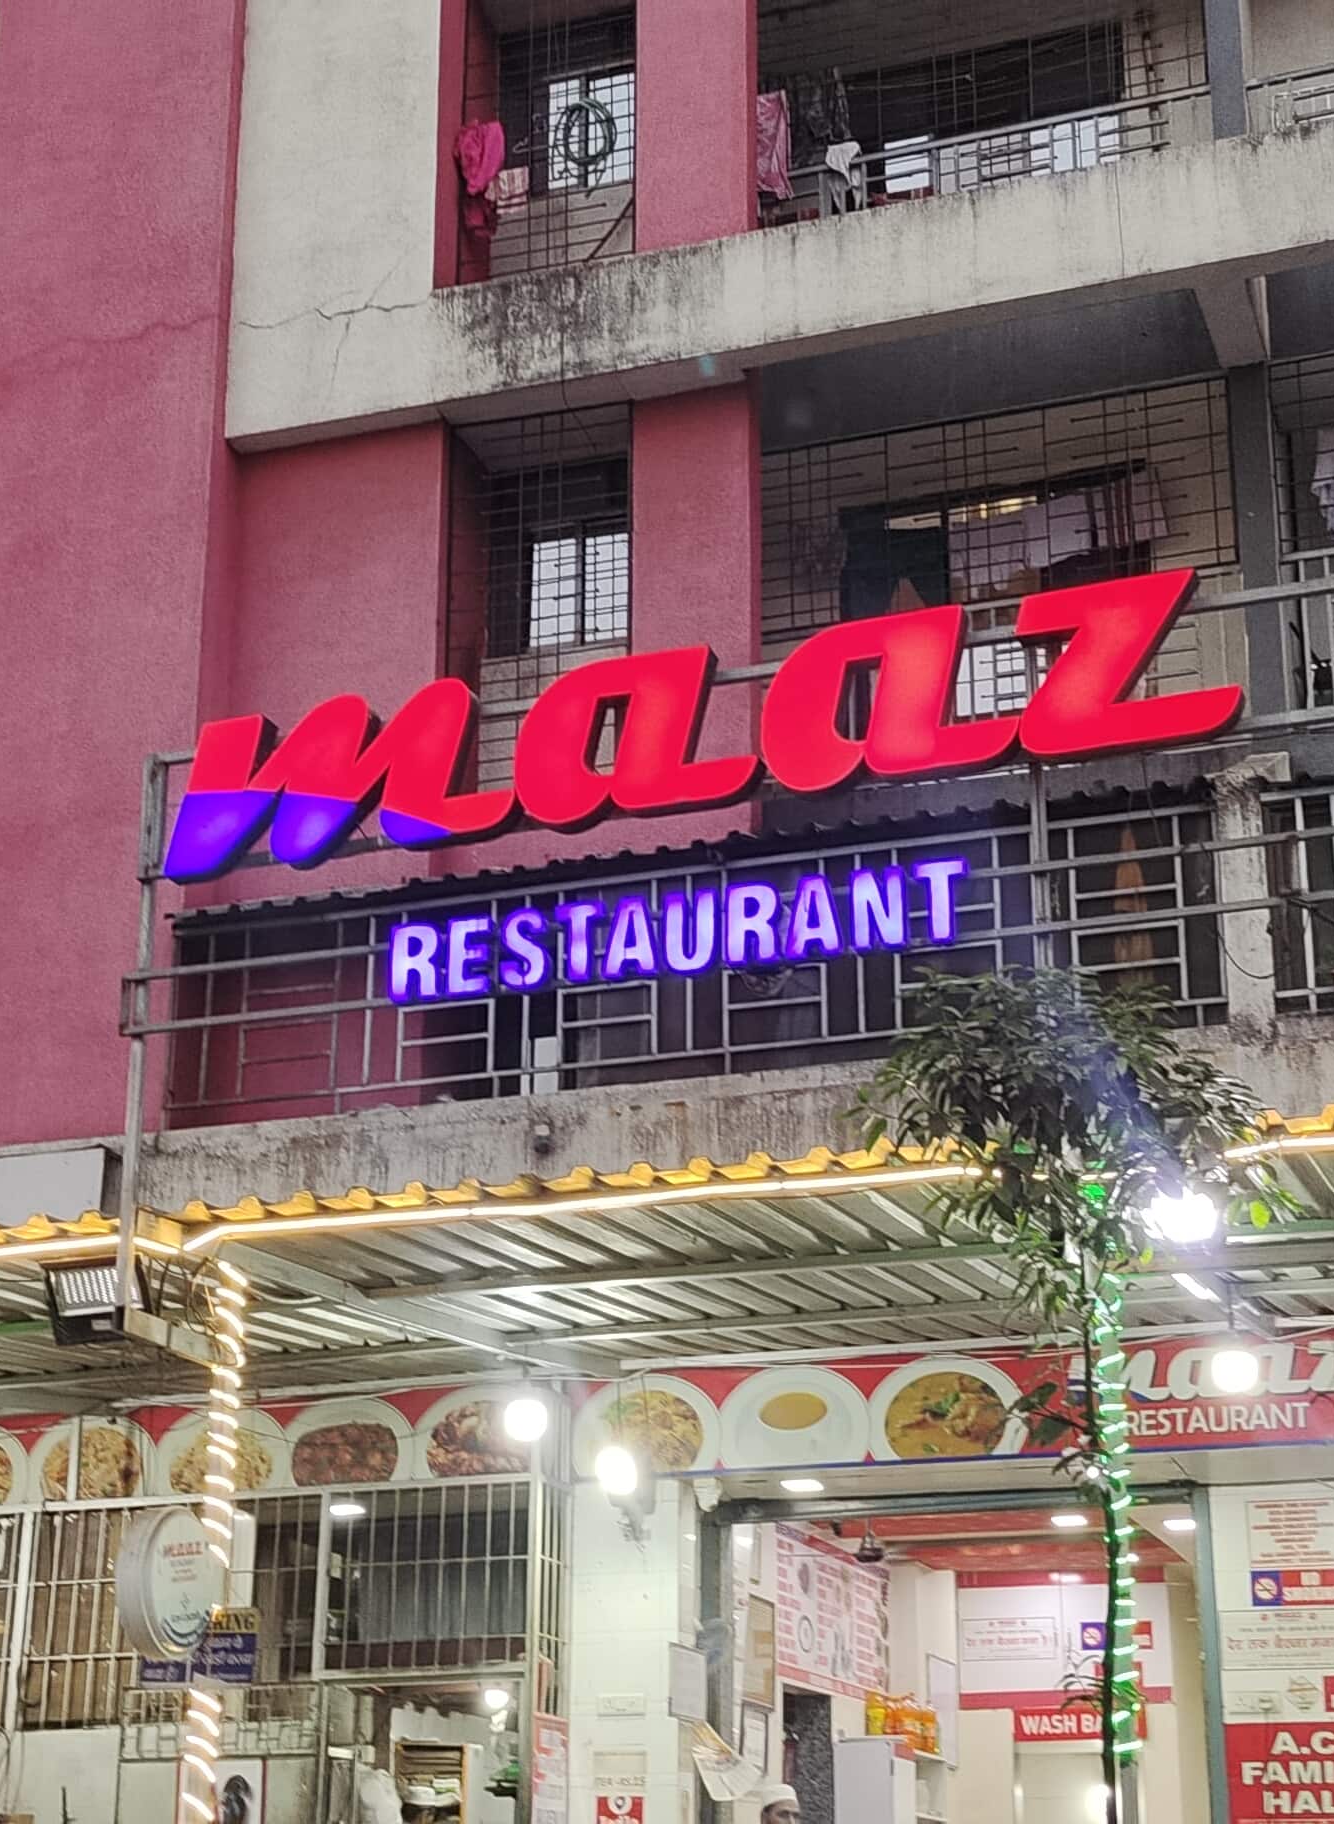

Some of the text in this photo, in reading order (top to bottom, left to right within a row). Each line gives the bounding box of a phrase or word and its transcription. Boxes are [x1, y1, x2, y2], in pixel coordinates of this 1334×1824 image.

[164, 568, 1245, 884] maaz
[387, 858, 967, 1002] RESTAURANT
[1123, 1402, 1312, 1437] RESTAURANT
[1020, 1714, 1078, 1735] WASH
